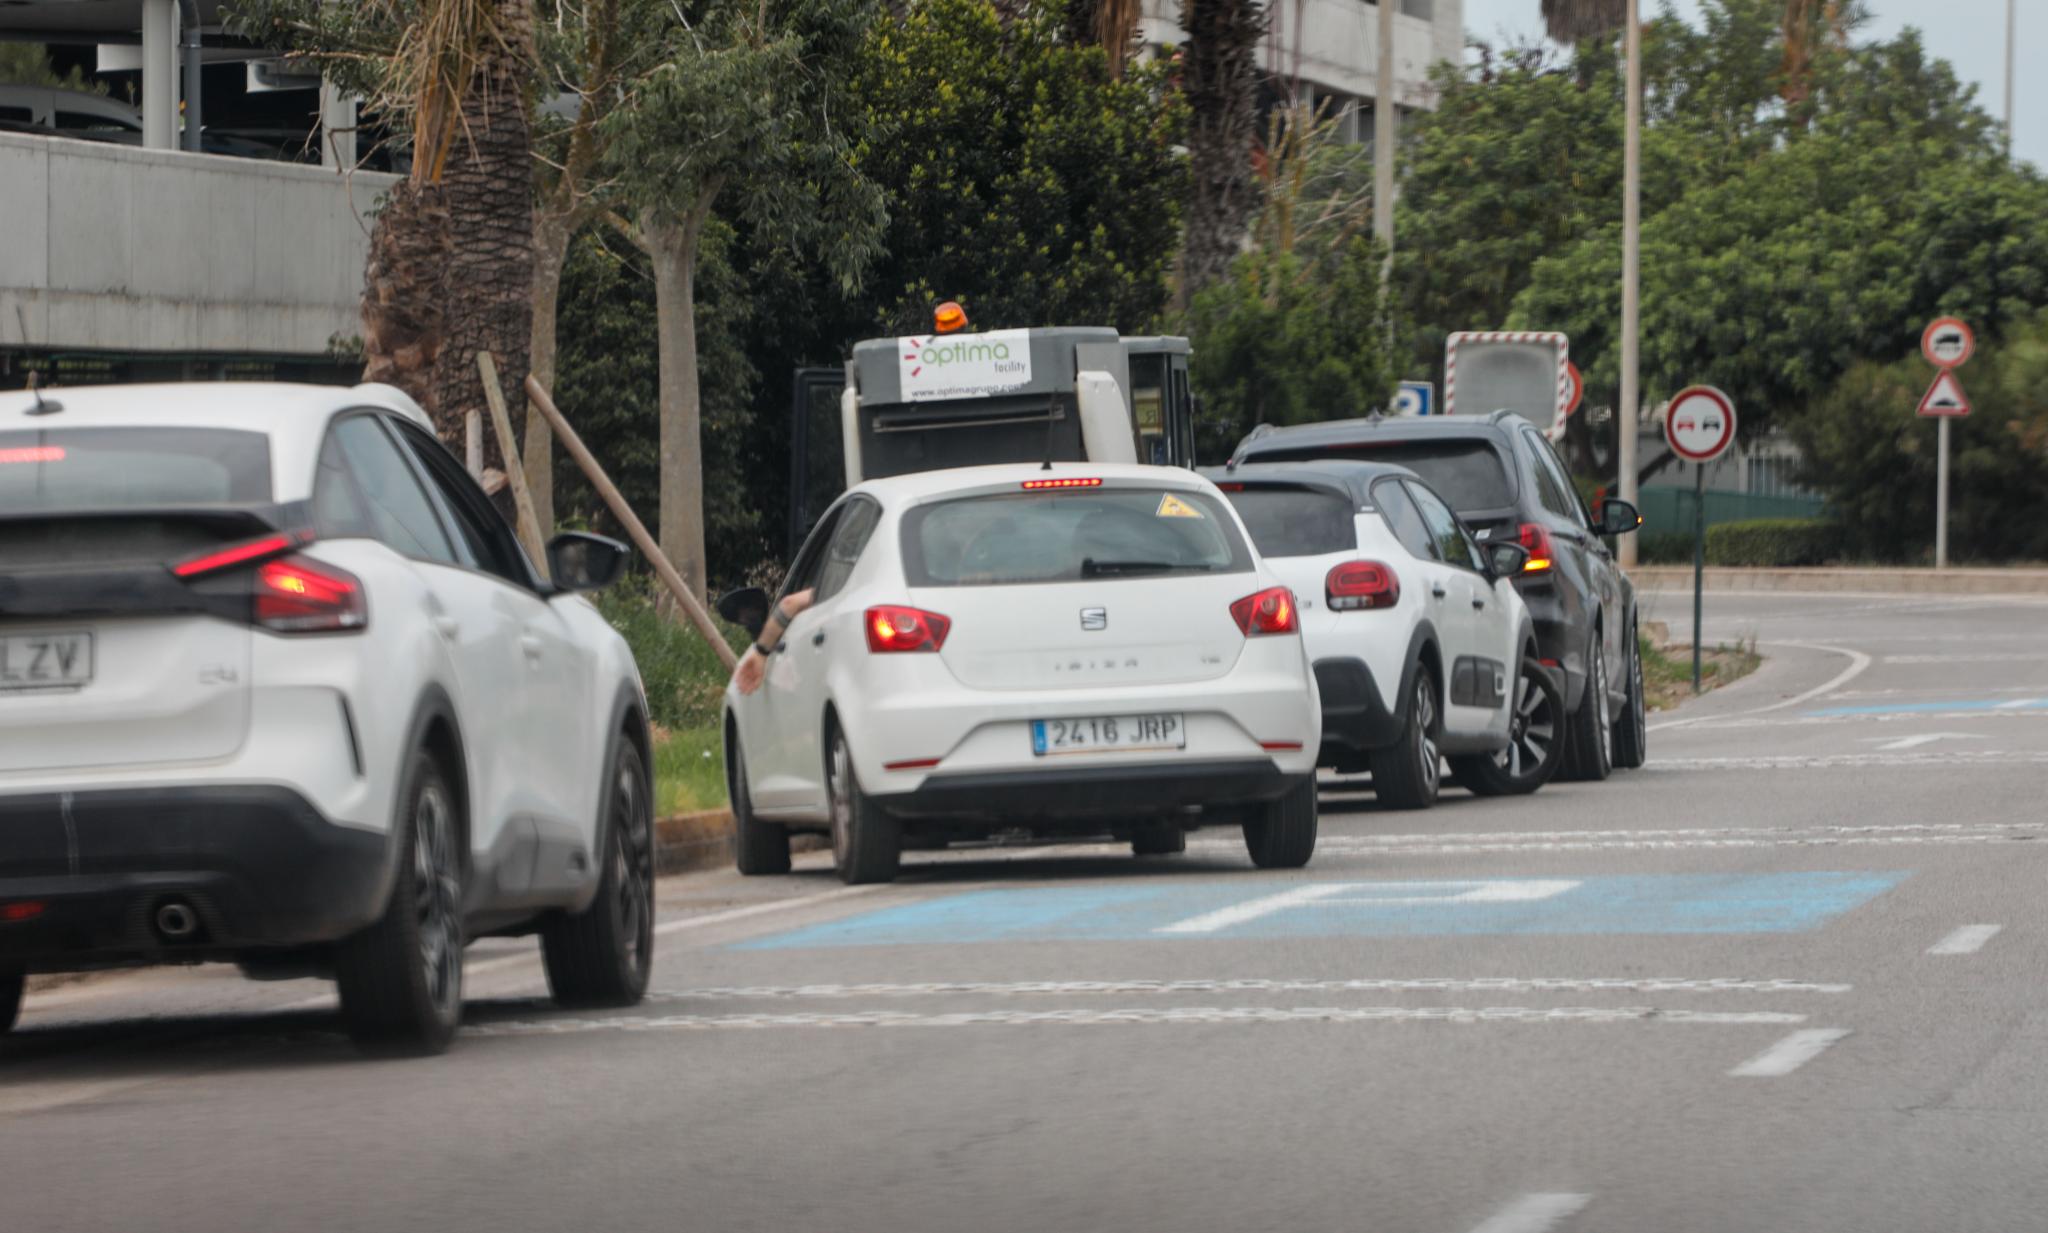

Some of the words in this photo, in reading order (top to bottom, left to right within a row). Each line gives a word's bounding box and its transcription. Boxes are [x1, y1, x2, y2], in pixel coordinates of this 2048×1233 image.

[922, 342, 1009, 367] optima
[994, 362, 1026, 373] facility
[0, 642, 77, 679] LZV
[1052, 717, 1118, 746] 2416
[1130, 714, 1177, 742] JRP
